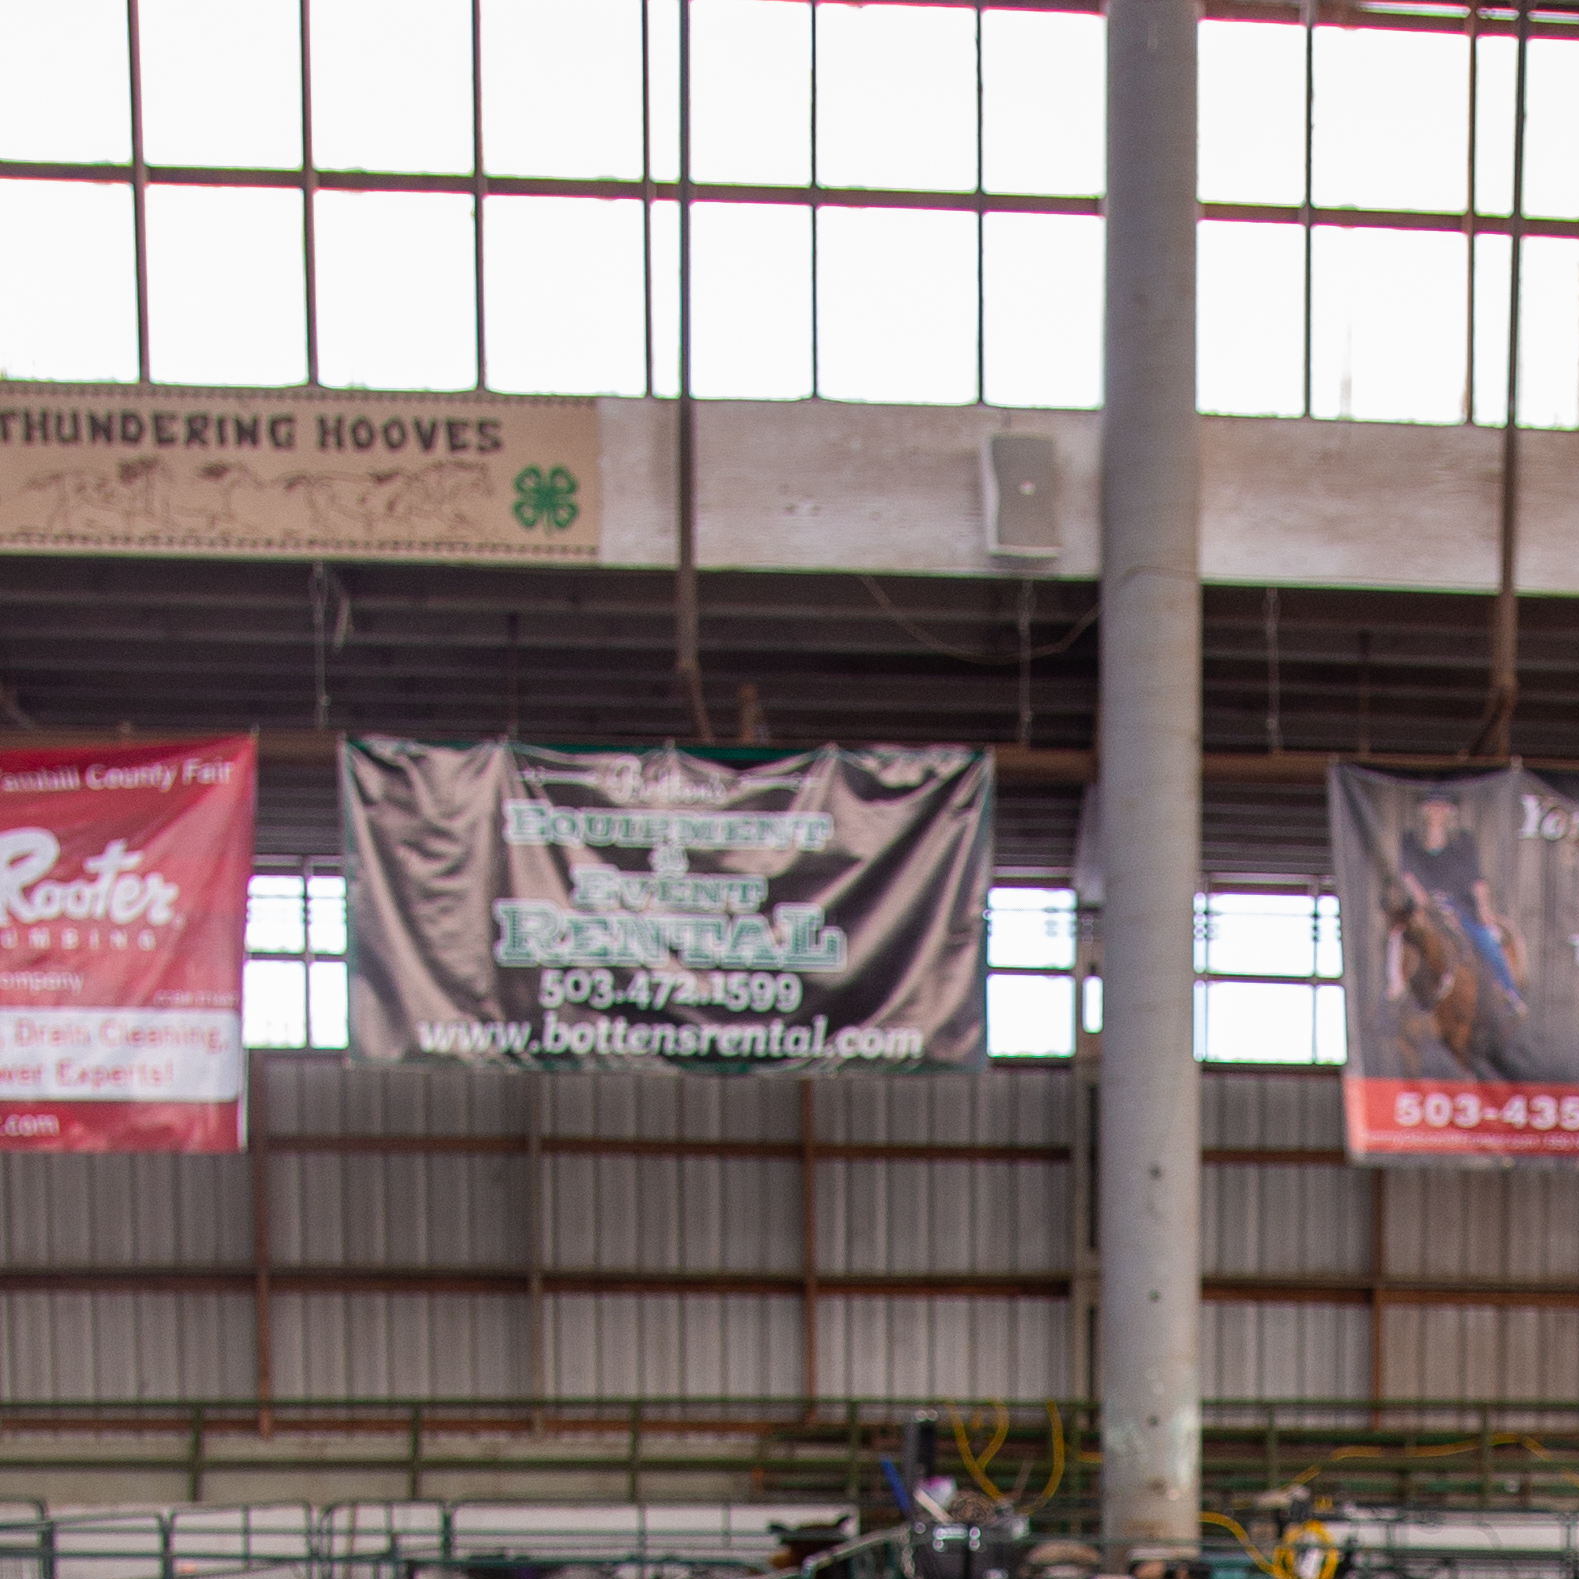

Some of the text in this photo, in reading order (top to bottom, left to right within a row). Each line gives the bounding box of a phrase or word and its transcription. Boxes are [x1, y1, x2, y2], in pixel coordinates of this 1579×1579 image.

[0, 406, 504, 455] THUNDERING HOOVES
[85, 763, 178, 793] County
[182, 757, 234, 786] Fair
[0, 827, 178, 926] Rooter
[538, 968, 803, 1012] 503.472.1599
[417, 1009, 925, 1061] www.bottensrental.com
